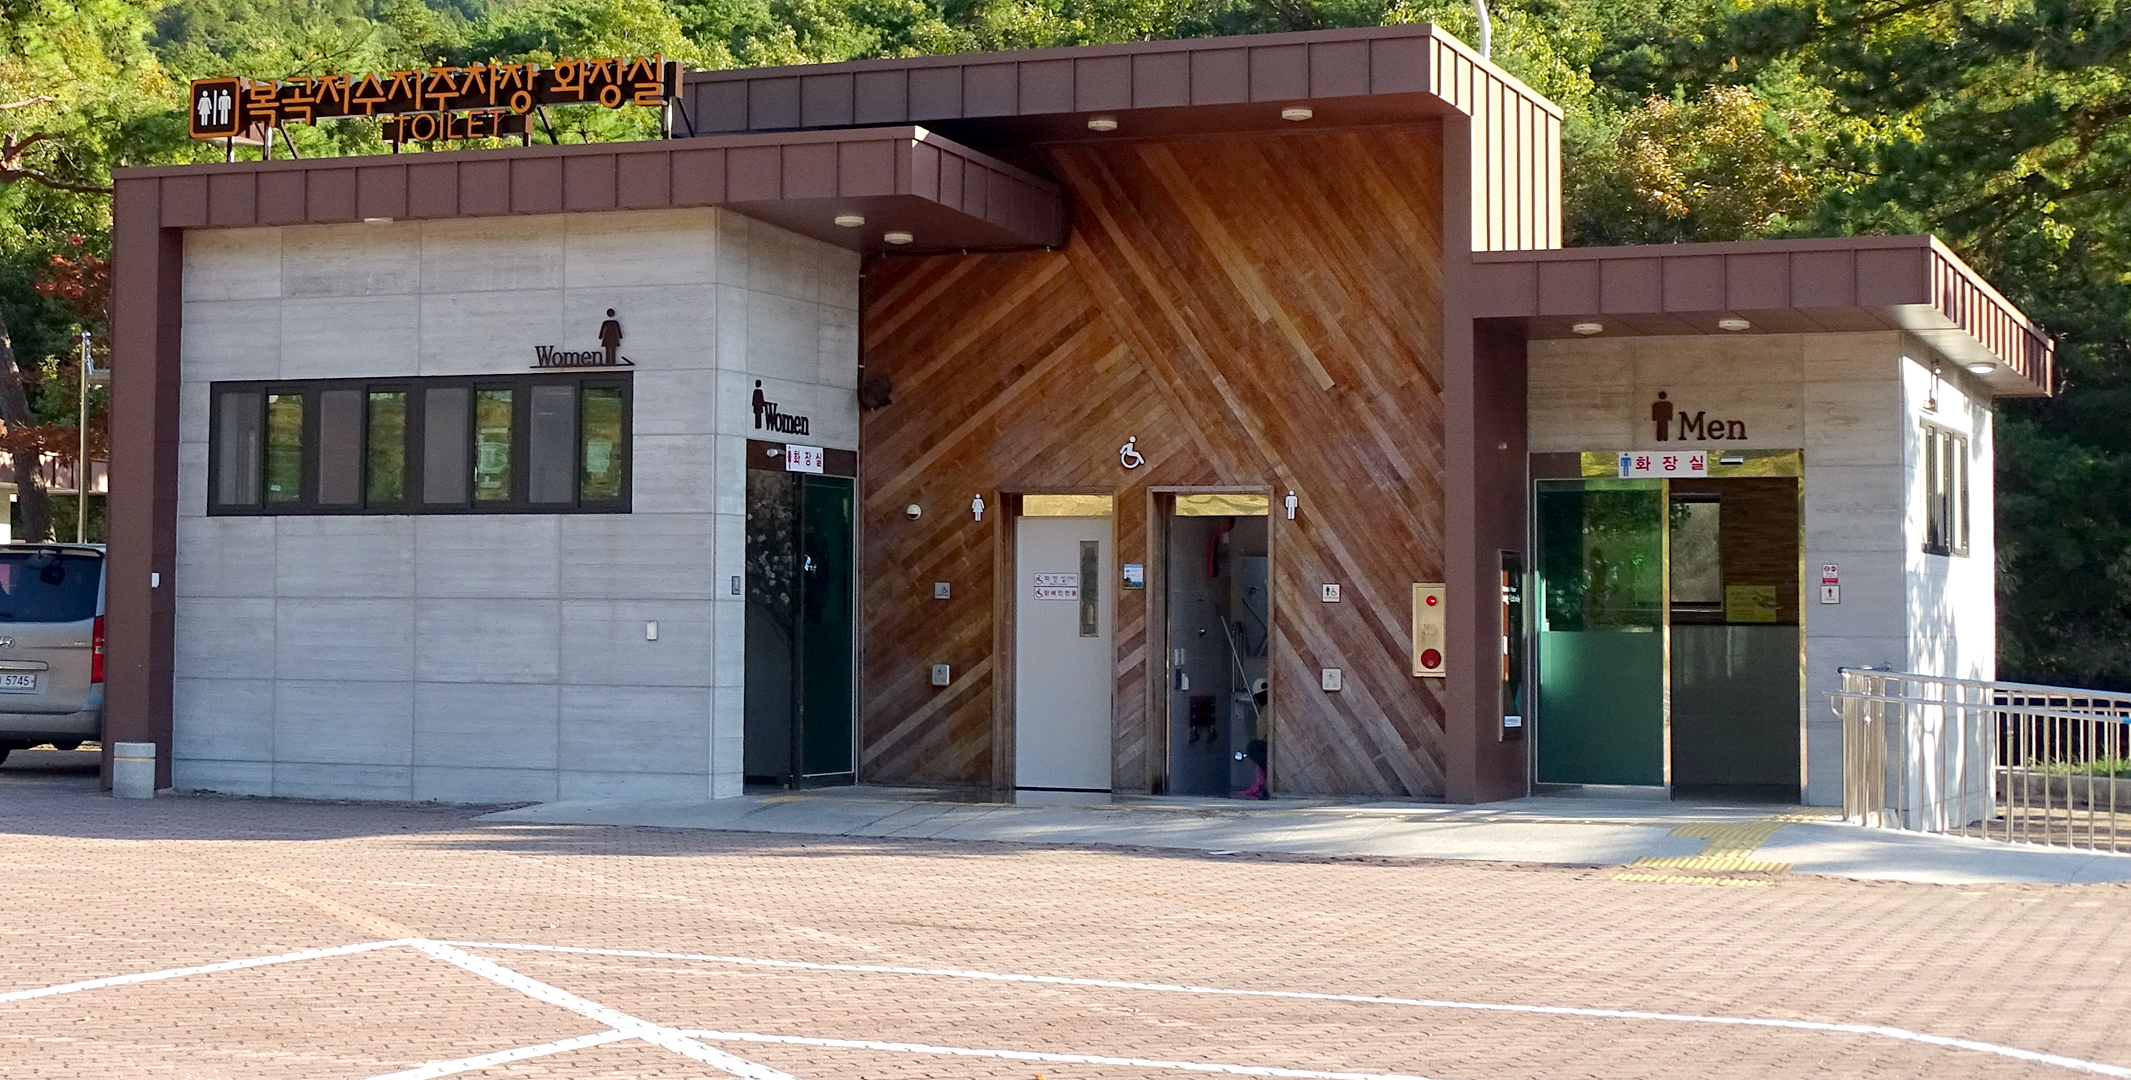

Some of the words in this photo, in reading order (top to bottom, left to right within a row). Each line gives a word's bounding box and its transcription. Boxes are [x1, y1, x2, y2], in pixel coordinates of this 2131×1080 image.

[246, 61, 540, 127] 복곡저수지주차장
[550, 53, 663, 108] 화장실
[394, 109, 507, 143] TOILET
[535, 345, 605, 366] Women
[764, 401, 810, 436] Women
[1678, 411, 1748, 441] Men
[5, 675, 30, 686] 5745
